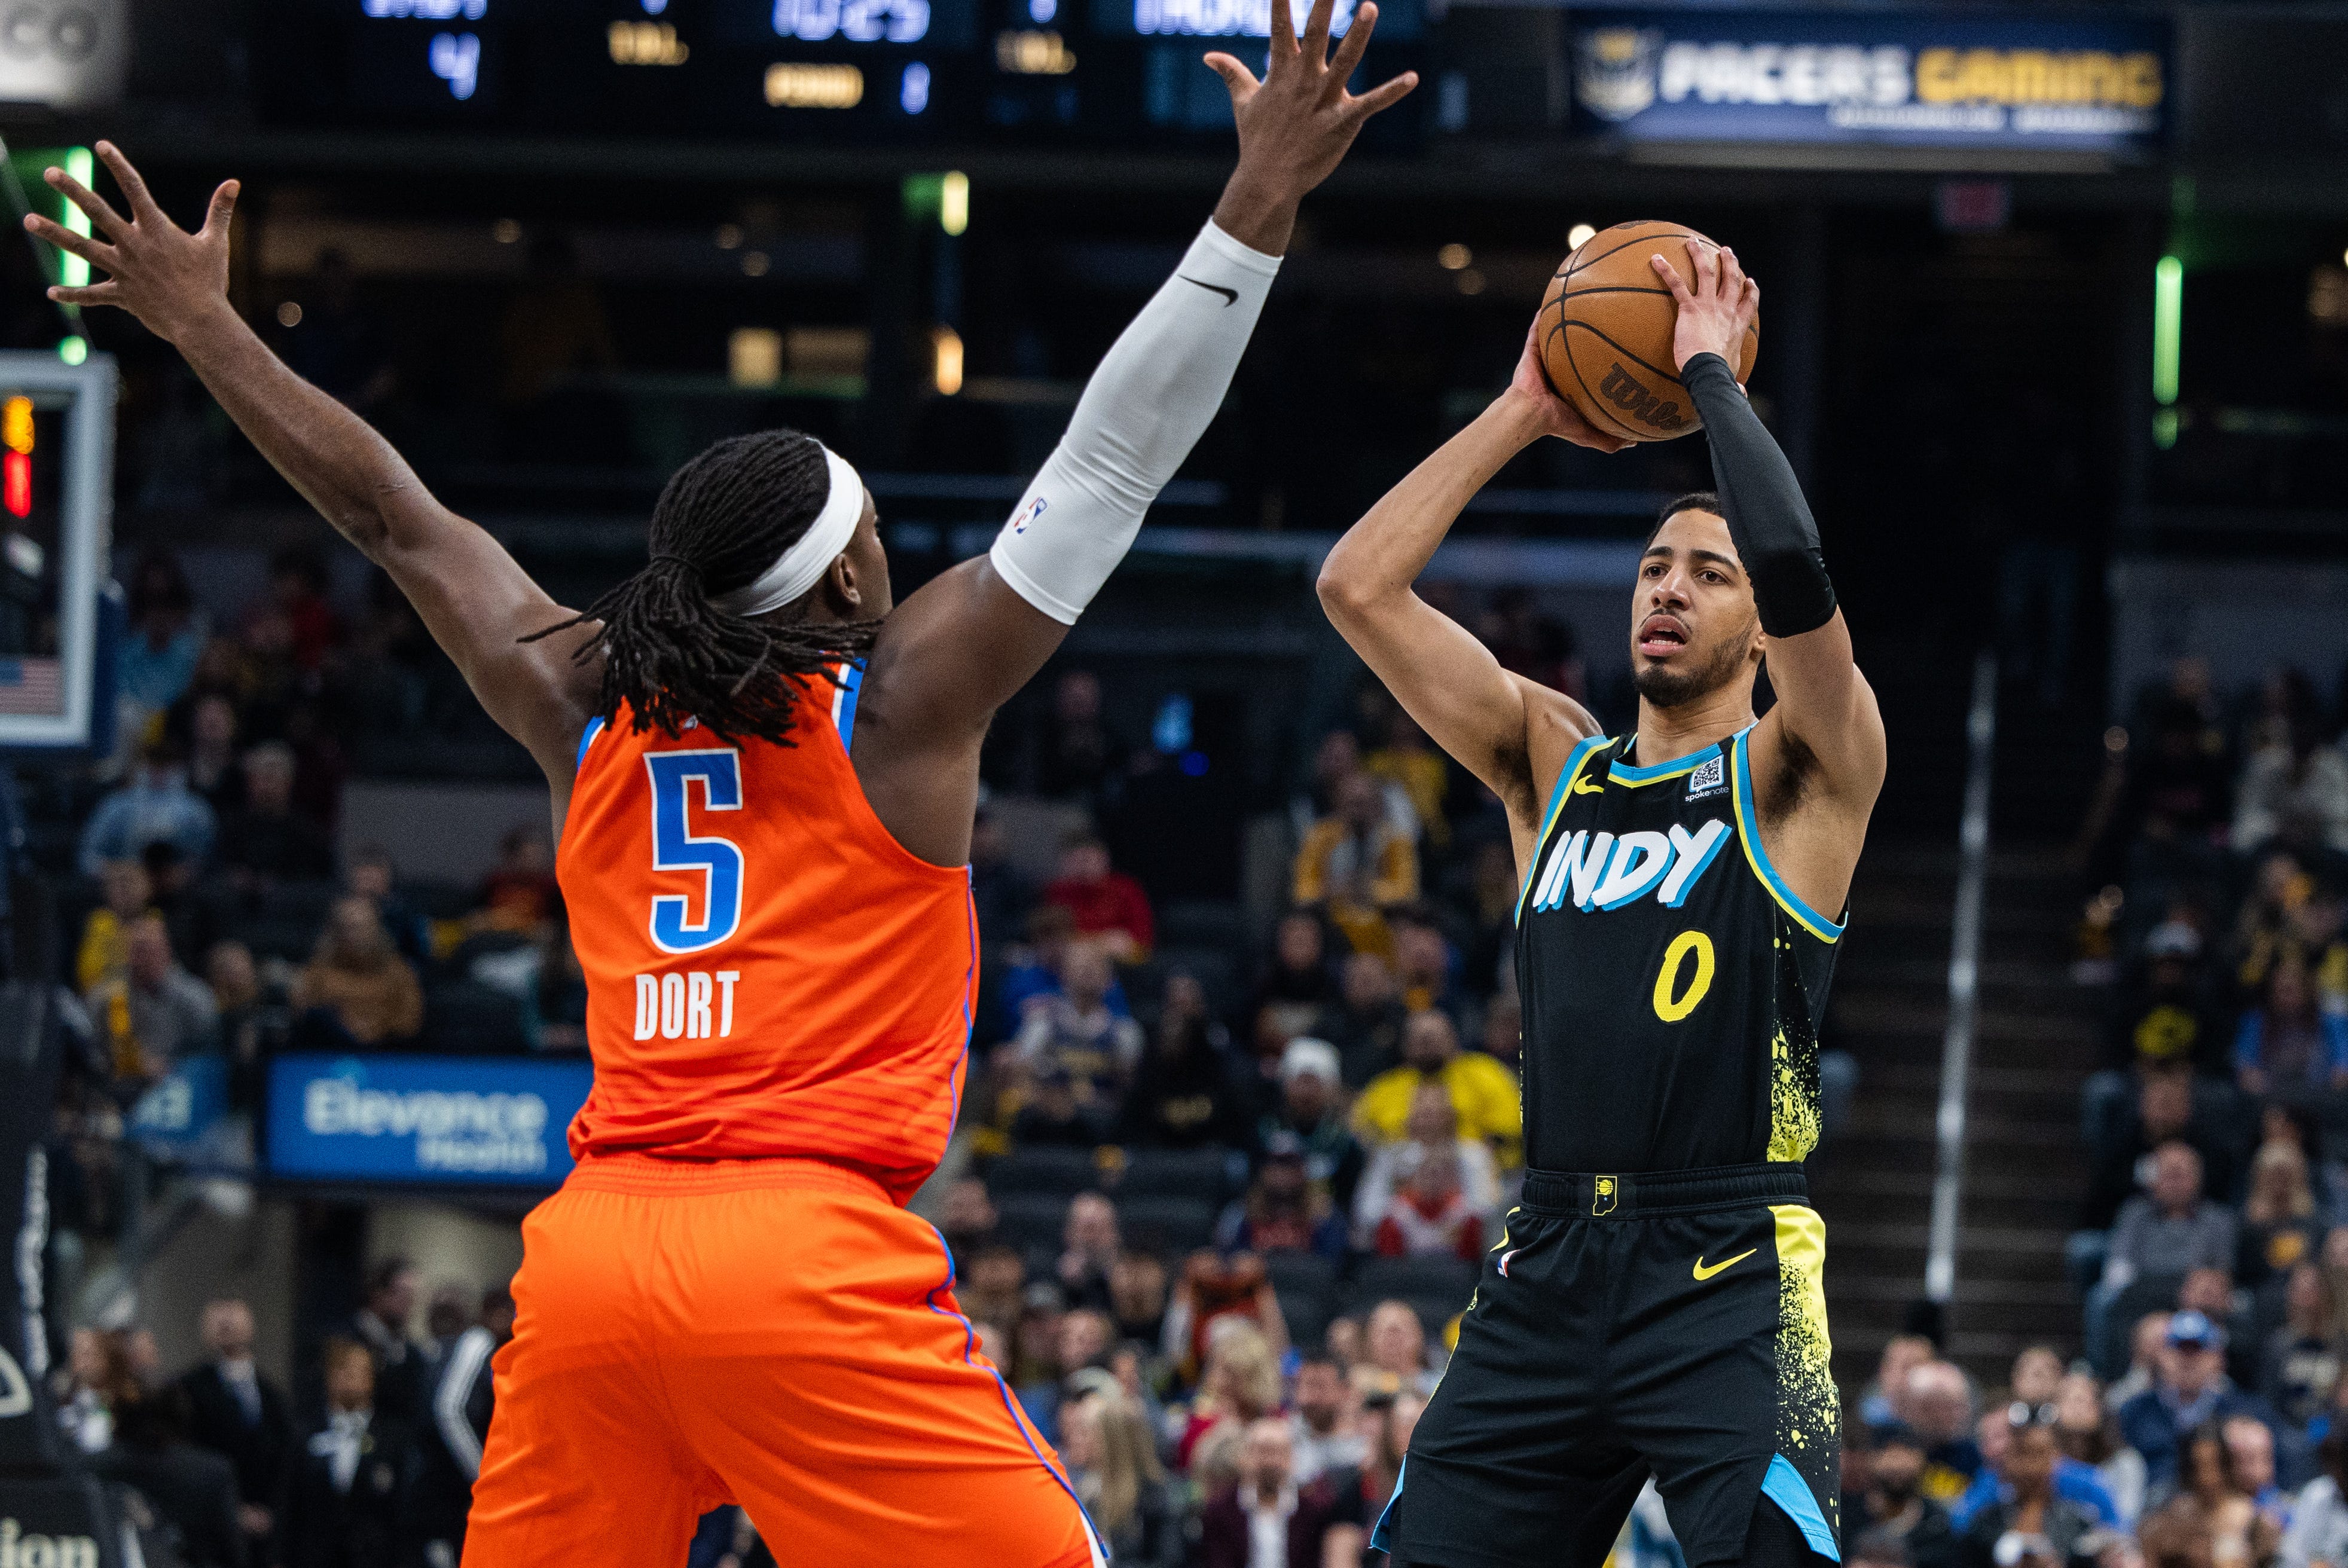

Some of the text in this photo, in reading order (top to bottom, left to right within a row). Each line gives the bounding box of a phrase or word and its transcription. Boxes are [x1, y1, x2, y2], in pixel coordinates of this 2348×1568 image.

[1660, 41, 1910, 105] PACERS
[1685, 786, 1729, 802] spokenote
[642, 748, 745, 955] 5
[1532, 818, 1732, 912] INDY
[634, 970, 740, 1041] DORT
[1653, 930, 1715, 1022] 0
[304, 1078, 548, 1136] Elevance
[416, 1136, 548, 1173] Health
